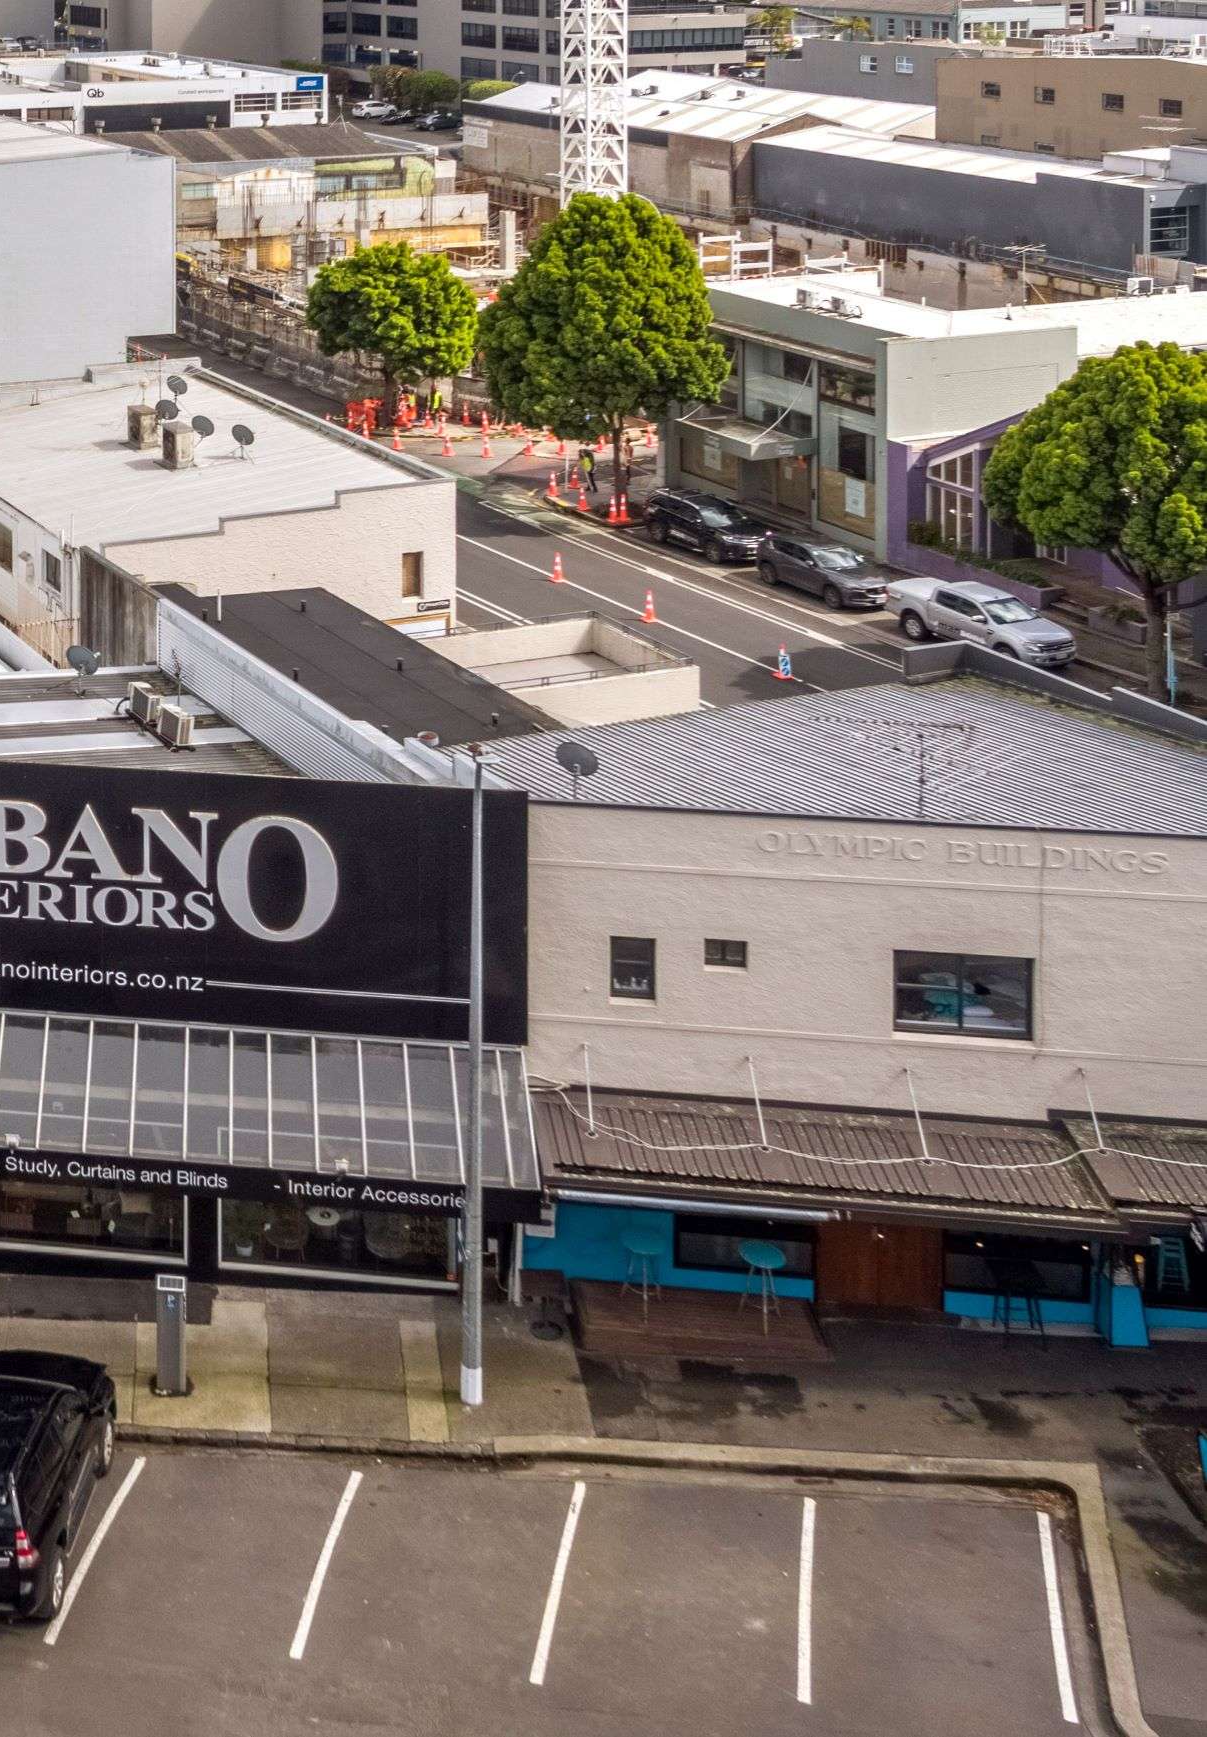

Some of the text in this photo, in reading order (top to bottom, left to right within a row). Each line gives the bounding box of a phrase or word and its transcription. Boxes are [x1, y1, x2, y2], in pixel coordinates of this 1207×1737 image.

[755, 830, 1170, 875] OLYMPIC BUILDINGS
[5, 1155, 62, 1177] Study,
[67, 1160, 136, 1182] Curtains
[140, 1167, 172, 1185] and
[177, 1170, 228, 1189] Blinds
[288, 1179, 355, 1200] Interior
[360, 1184, 467, 1209] Accessorie
